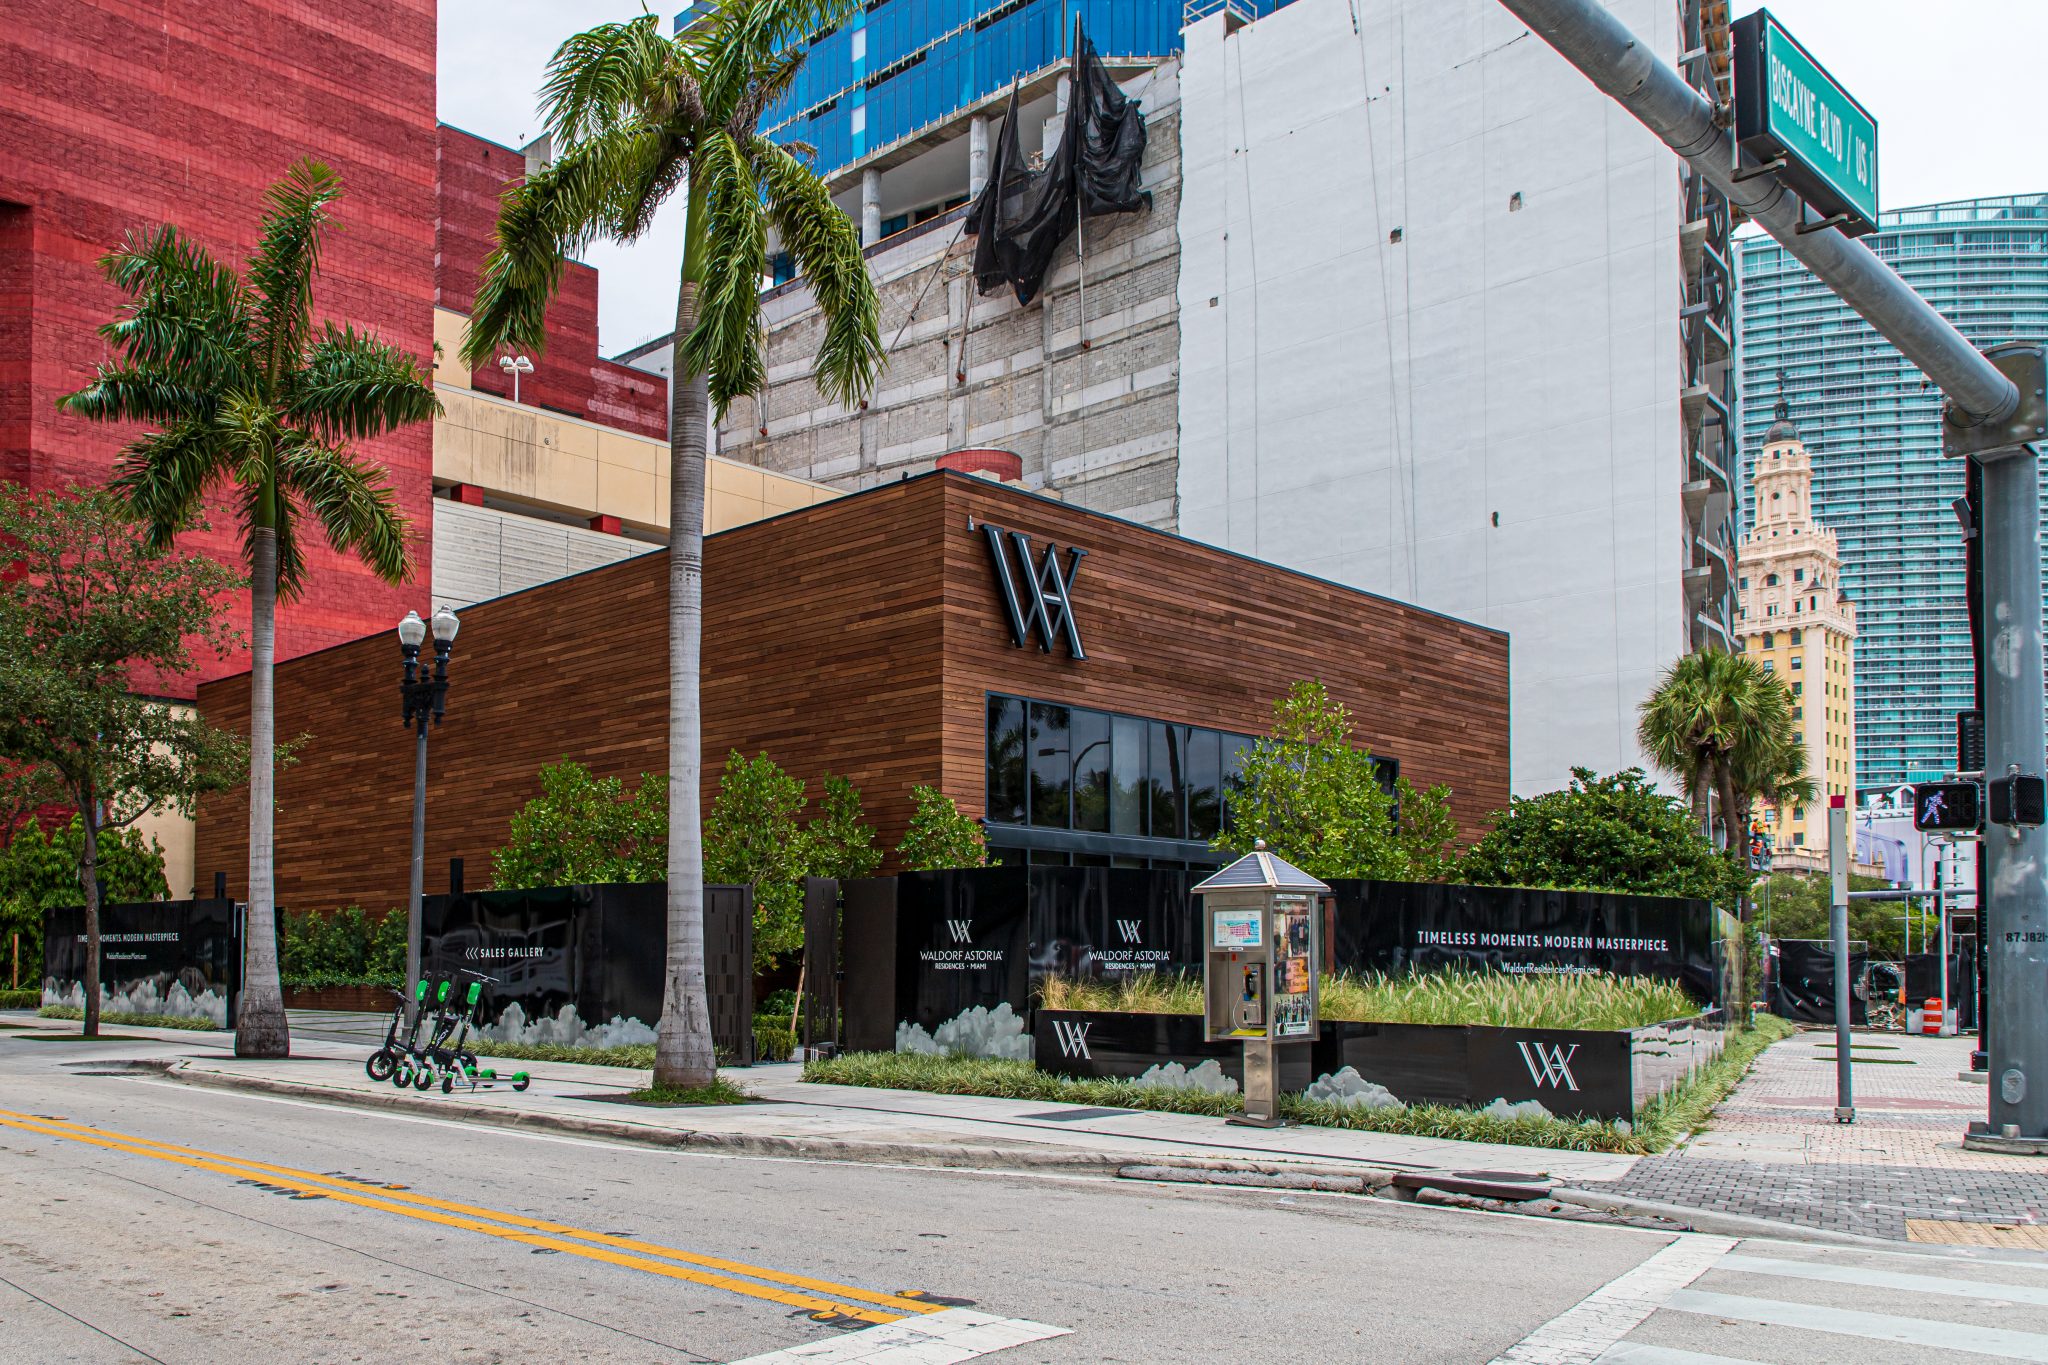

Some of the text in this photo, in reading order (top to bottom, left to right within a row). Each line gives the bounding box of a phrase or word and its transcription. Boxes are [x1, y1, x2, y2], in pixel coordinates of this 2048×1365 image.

[1772, 54, 1817, 139] BISCAYNE
[1820, 101, 1843, 164] BLVD
[1856, 136, 1867, 188] US
[1870, 150, 1875, 193] 1
[122, 934, 144, 943] MODERN
[1417, 930, 1669, 952] TIMELESS MOMENTS. MODERN MASTERPIECE.
[480, 946, 544, 958] SALES GALLERY
[920, 950, 964, 961] WALDORF
[1088, 950, 1134, 961] WALDORF
[934, 962, 987, 970] RESIDENCES MIAMI
[1104, 962, 1156, 970] RESIDENCES MIAMI
